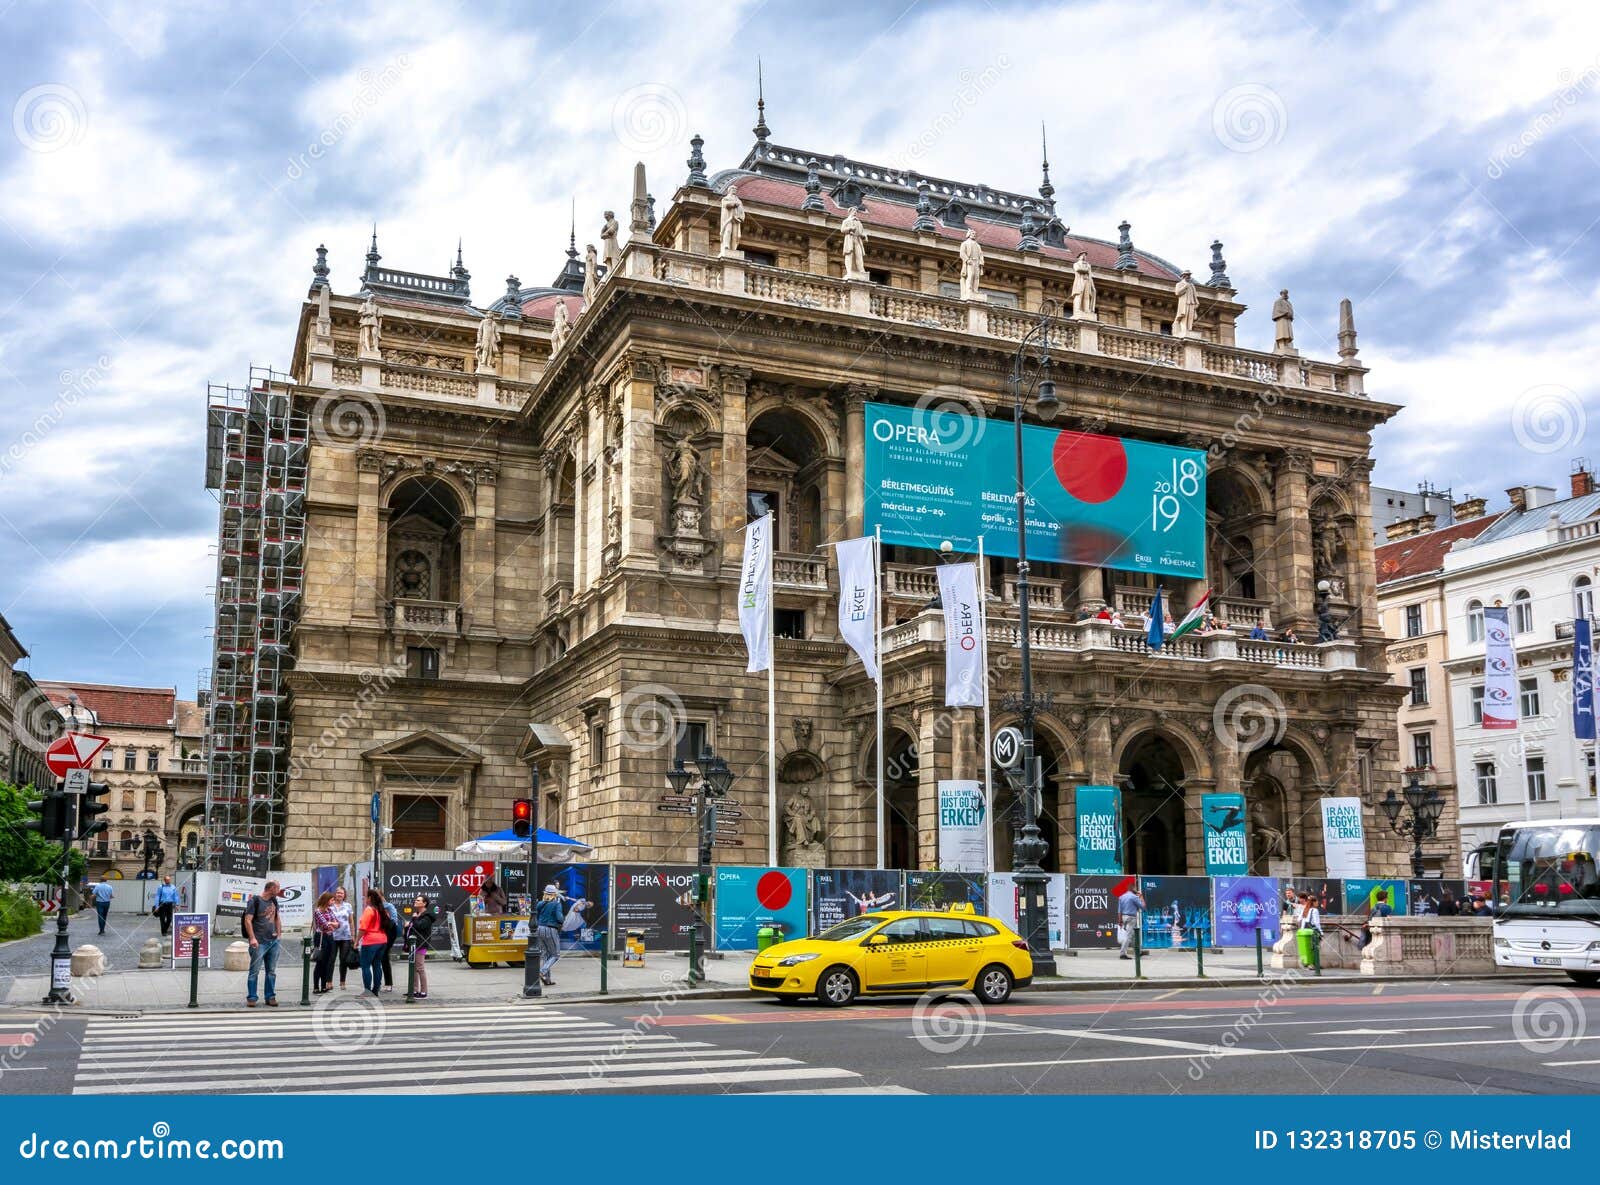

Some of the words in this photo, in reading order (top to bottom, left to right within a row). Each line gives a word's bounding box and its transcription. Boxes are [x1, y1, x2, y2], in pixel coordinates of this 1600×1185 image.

[872, 419, 942, 446] OPERA
[1172, 458, 1199, 497] 18
[881, 478, 954, 497] BÉRLETMEGÚJÍTÁS
[1153, 481, 1171, 494] 20
[881, 502, 914, 512] március
[1152, 494, 1180, 533] 19
[981, 512, 1005, 523] április
[1048, 522, 1061, 531] 29.
[941, 798, 957, 808] JUST
[1208, 837, 1224, 848] JUST
[1225, 837, 1236, 848] GO
[1208, 847, 1245, 865] ERKEL
[390, 874, 441, 887] OPERA
[444, 874, 486, 887] VISIT
[719, 872, 740, 881] OPERA
[1074, 895, 1108, 910] OPEN
